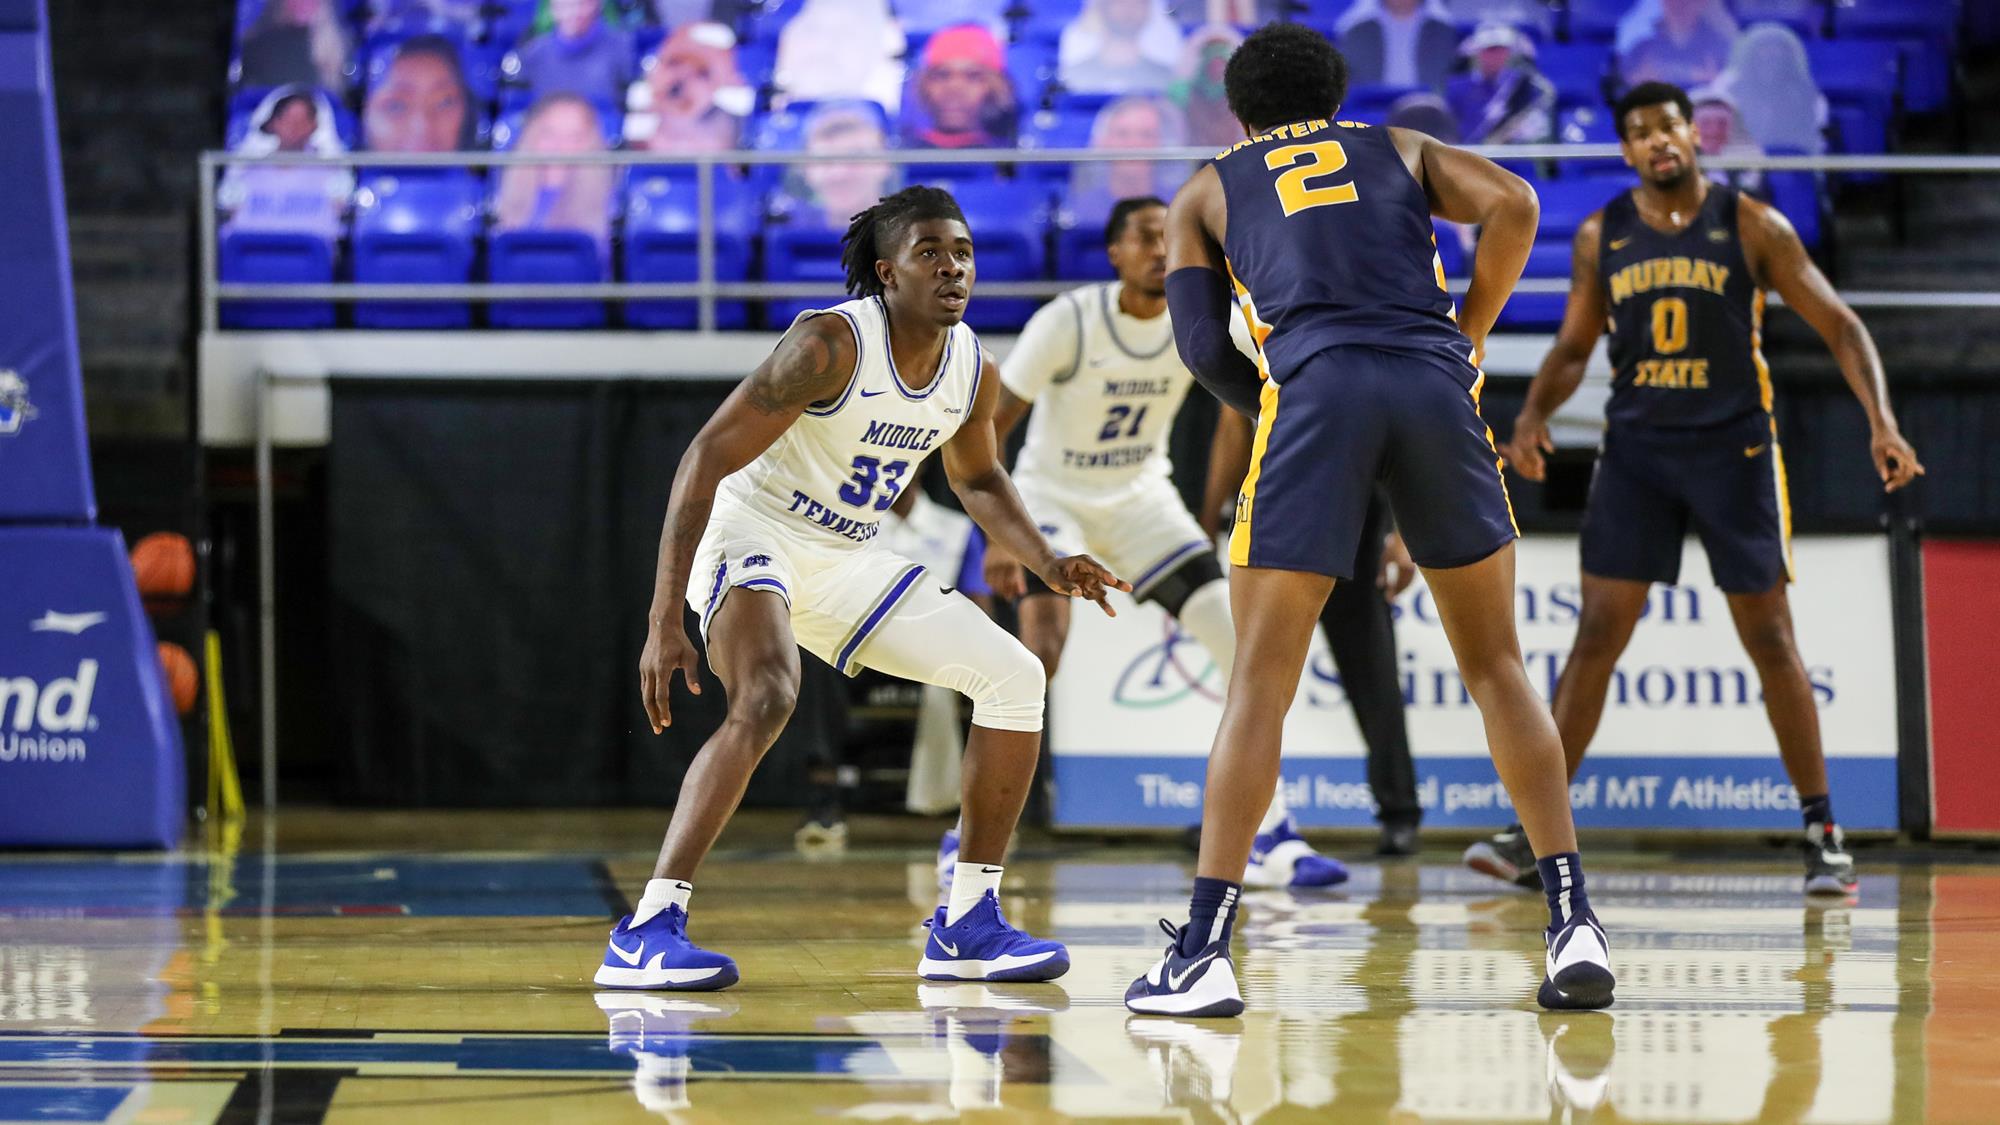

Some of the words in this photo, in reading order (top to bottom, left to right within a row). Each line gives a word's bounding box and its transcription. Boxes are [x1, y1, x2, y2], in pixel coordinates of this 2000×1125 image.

[1264, 140, 1359, 217] 2
[1610, 256, 1729, 305] MURRAY
[1652, 297, 1687, 355] 0
[1633, 358, 1708, 389] STATE
[860, 420, 939, 451] MIDDLE
[1098, 405, 1148, 442] 21
[837, 455, 909, 512] 33
[0, 731, 86, 762] Union
[1136, 773, 1199, 808] The
[1568, 775, 1597, 809] of
[1605, 776, 1660, 809] MT
[1668, 775, 1801, 811] Athletics
